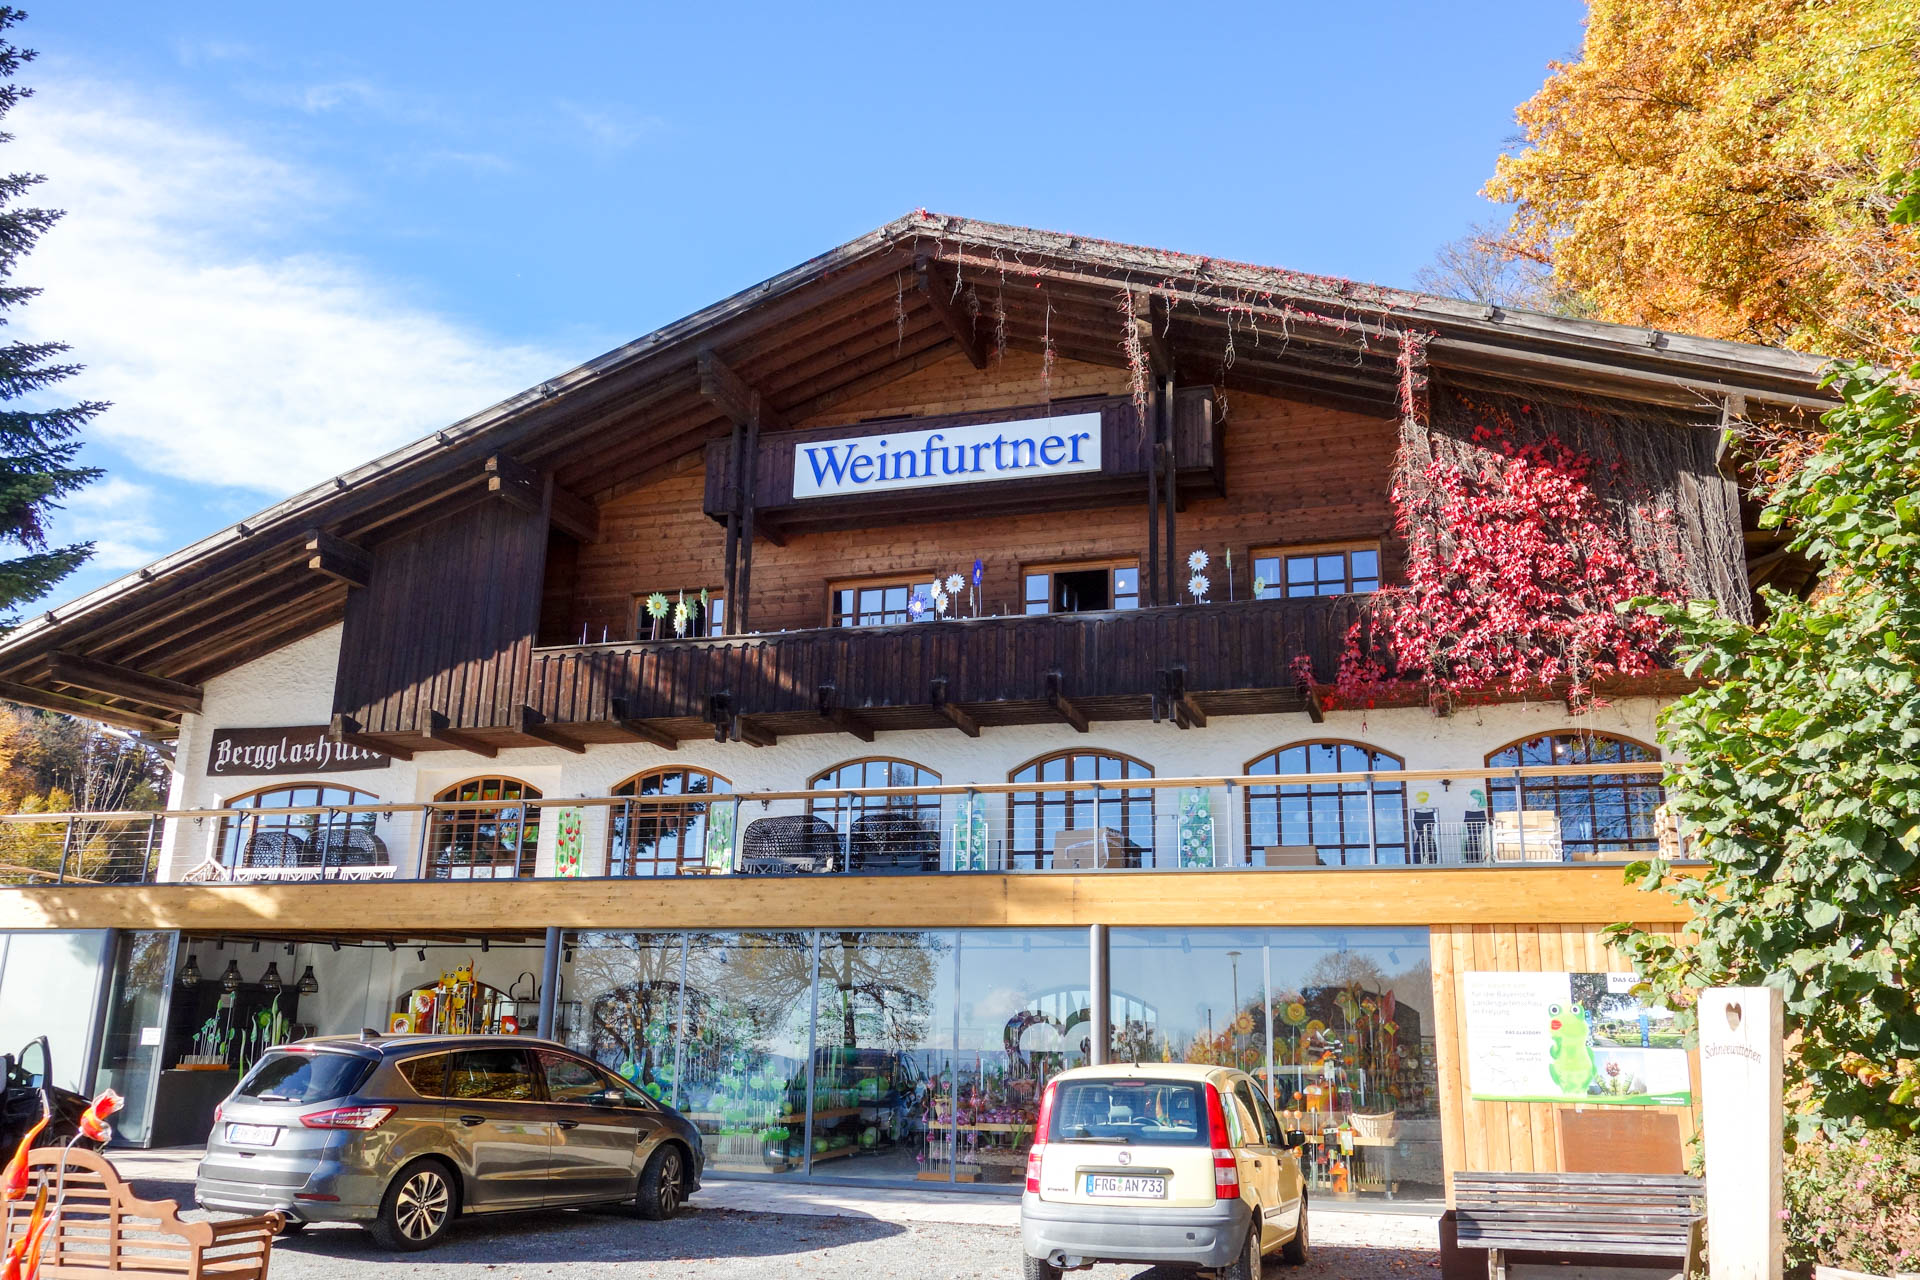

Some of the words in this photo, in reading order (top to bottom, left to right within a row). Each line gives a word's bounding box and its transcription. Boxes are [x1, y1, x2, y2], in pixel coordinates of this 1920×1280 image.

[803, 432, 1090, 488] Weinfurtner
[1704, 1042, 1761, 1064] Schneewittchen
[1094, 1178, 1116, 1191] FRG
